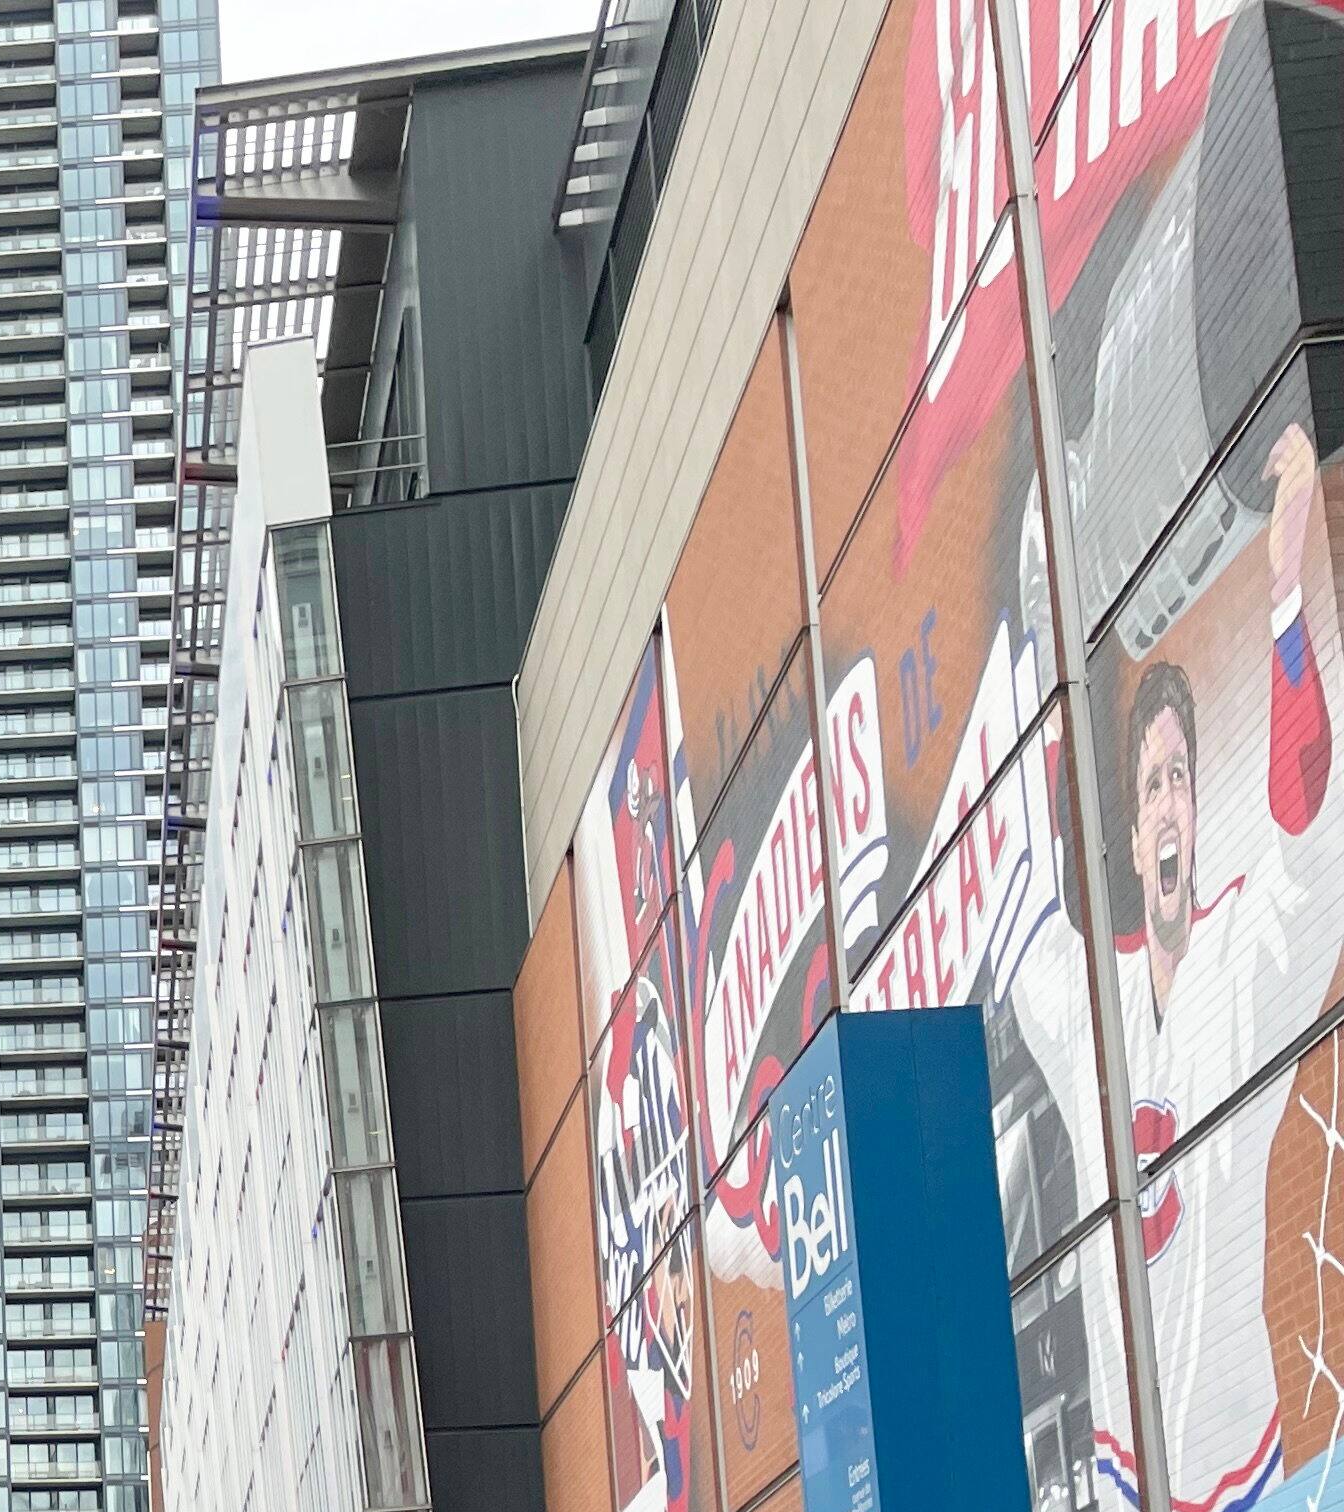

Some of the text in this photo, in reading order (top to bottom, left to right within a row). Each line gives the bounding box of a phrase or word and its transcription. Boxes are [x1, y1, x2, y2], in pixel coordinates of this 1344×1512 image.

[777, 1074, 836, 1169] Centre
[783, 1129, 849, 1300] Bell
[729, 1348, 760, 1405] 1909
